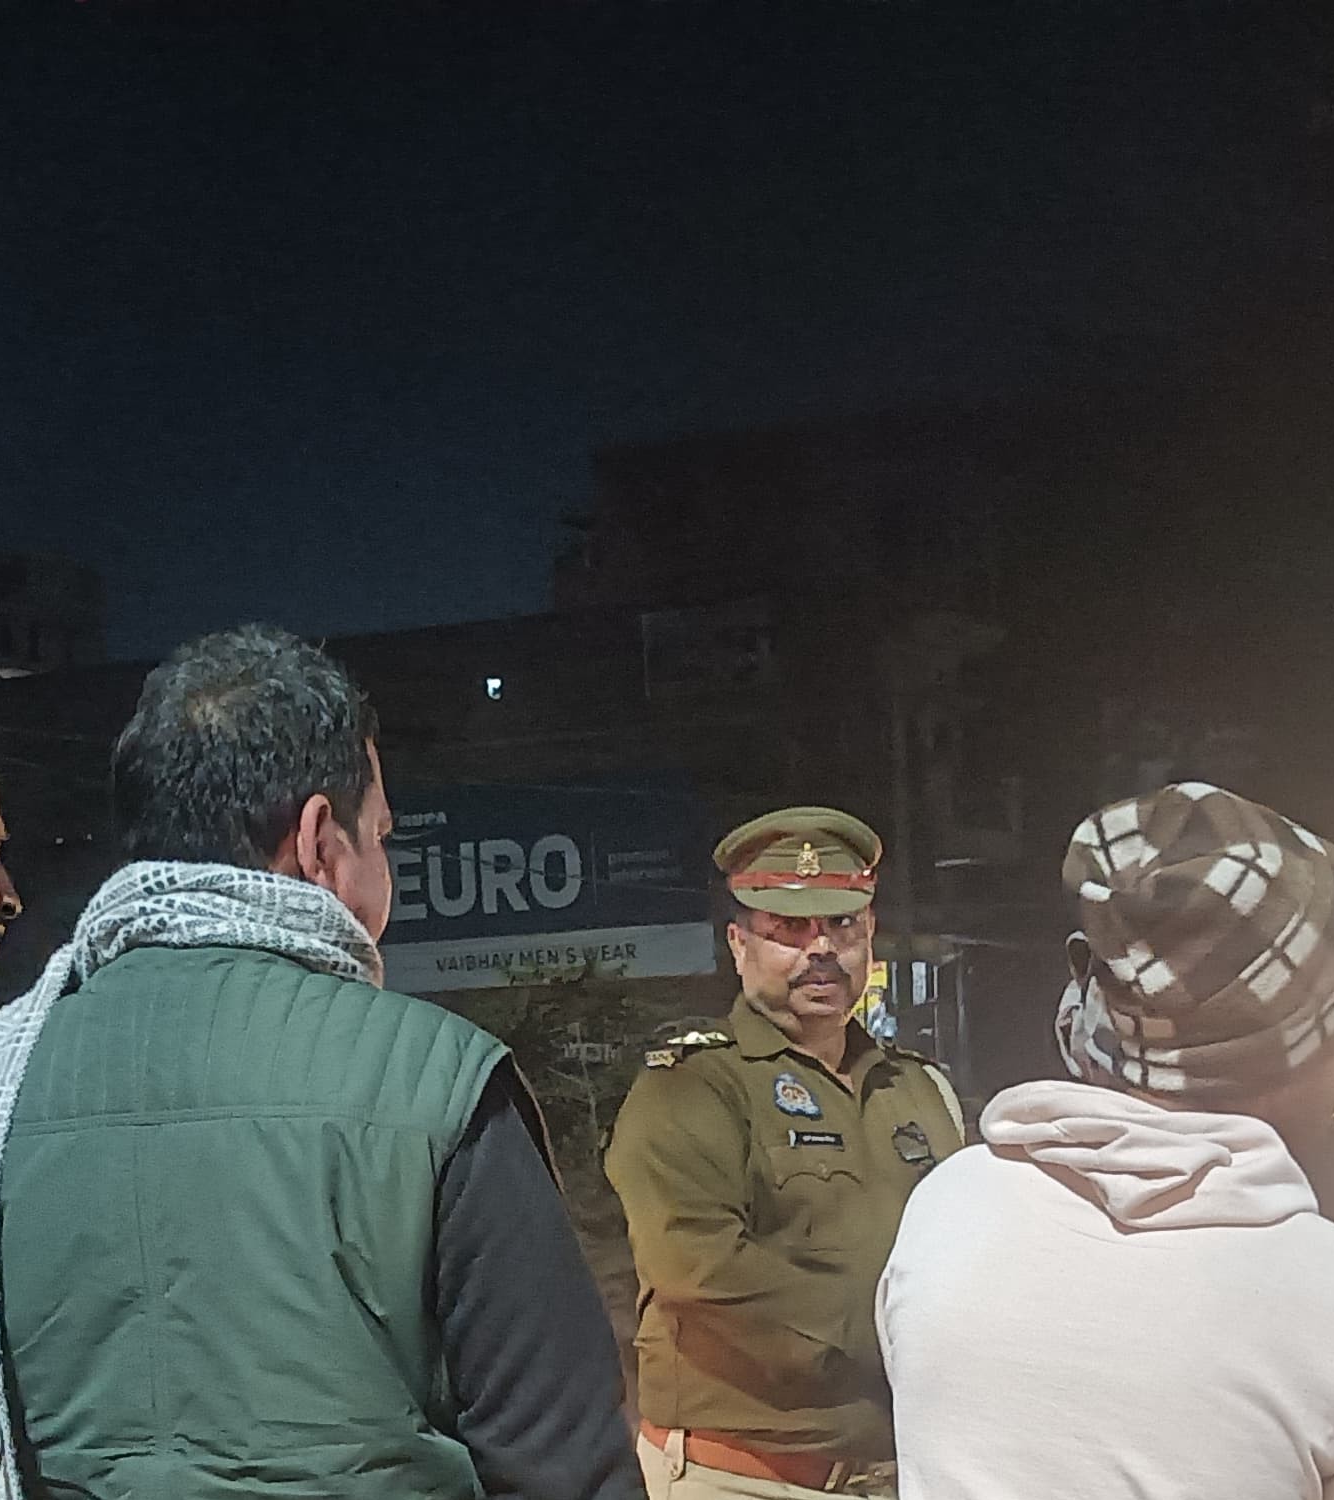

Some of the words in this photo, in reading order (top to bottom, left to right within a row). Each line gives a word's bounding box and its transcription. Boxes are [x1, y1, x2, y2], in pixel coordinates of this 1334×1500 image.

[390, 833, 583, 922] EURO
[435, 949, 514, 973] VAIBHAV
[584, 943, 639, 962] WEAR
